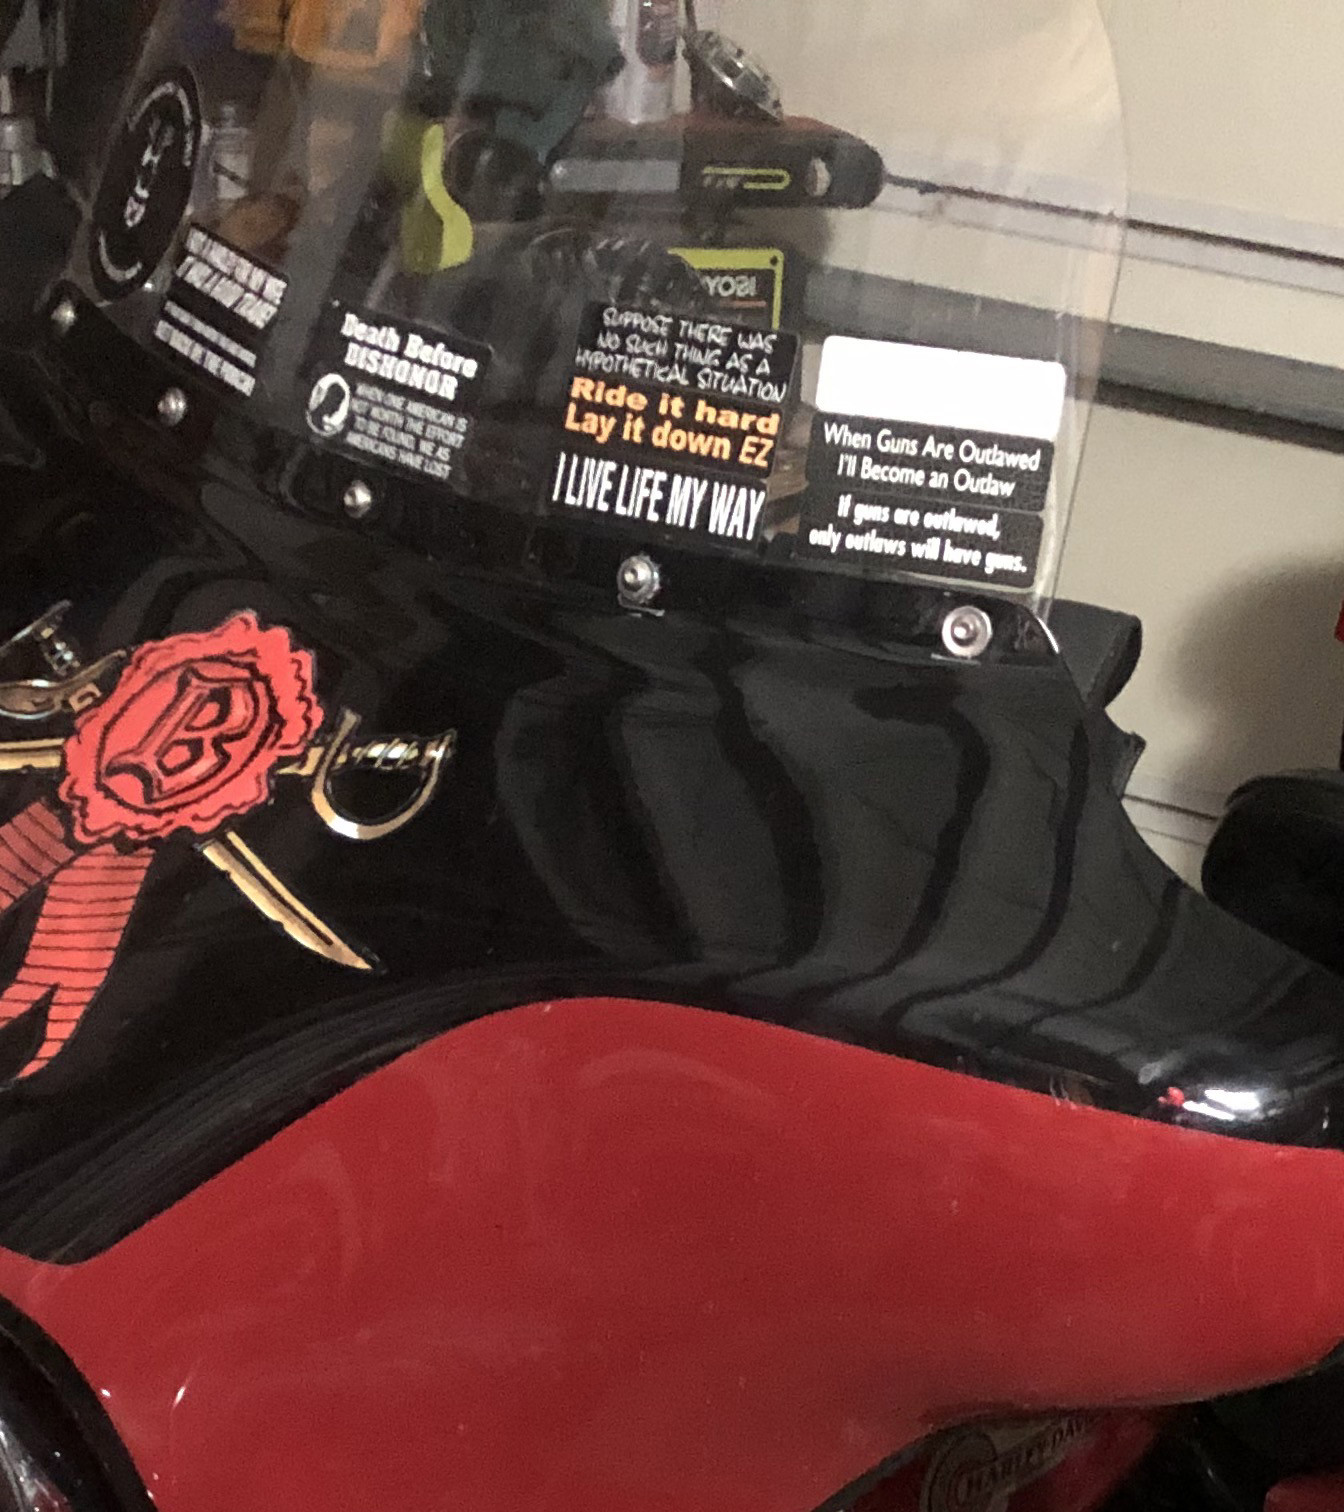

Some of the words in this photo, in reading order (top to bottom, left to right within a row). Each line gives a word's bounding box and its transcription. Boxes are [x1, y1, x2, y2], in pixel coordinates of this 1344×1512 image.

[703, 275, 757, 297] YOBI
[340, 311, 401, 353] Death
[403, 332, 479, 380] Before
[597, 330, 621, 351] NO
[625, 333, 669, 357] SUCH
[674, 341, 722, 367] THING
[725, 352, 753, 374] AS
[755, 357, 771, 376] A
[602, 306, 673, 337] SUPPOSE
[678, 319, 733, 347] THERE
[737, 332, 777, 354] WAS
[343, 341, 459, 401] DISHONOR
[574, 347, 690, 386] HYPOTHETICAL
[696, 367, 787, 403] SITUATION
[570, 376, 648, 411] Ride
[658, 392, 685, 419] it
[694, 399, 781, 436] hard
[564, 401, 617, 444] Lay
[622, 412, 647, 444] it
[651, 419, 732, 461] down
[738, 434, 775, 468] EZ
[823, 421, 872, 450] When
[876, 428, 919, 456] Guns
[922, 434, 955, 461] Are
[958, 439, 1041, 472] Outlawed
[552, 451, 567, 502] I
[564, 453, 617, 512] LIVE
[614, 464, 668, 523] LIFE
[665, 473, 709, 530] MY
[707, 480, 766, 541] WAY
[837, 452, 857, 477] I'll
[860, 456, 926, 486] Become
[928, 470, 949, 489] an
[953, 468, 1016, 497] Outlaw
[837, 493, 852, 518] If
[853, 502, 890, 526] guns
[893, 507, 920, 527] are
[923, 508, 1001, 541] outlawed,
[808, 523, 842, 554] only
[844, 529, 907, 557] outlaws
[910, 536, 941, 562] will
[942, 537, 982, 567] have
[984, 550, 1028, 575] guns.
